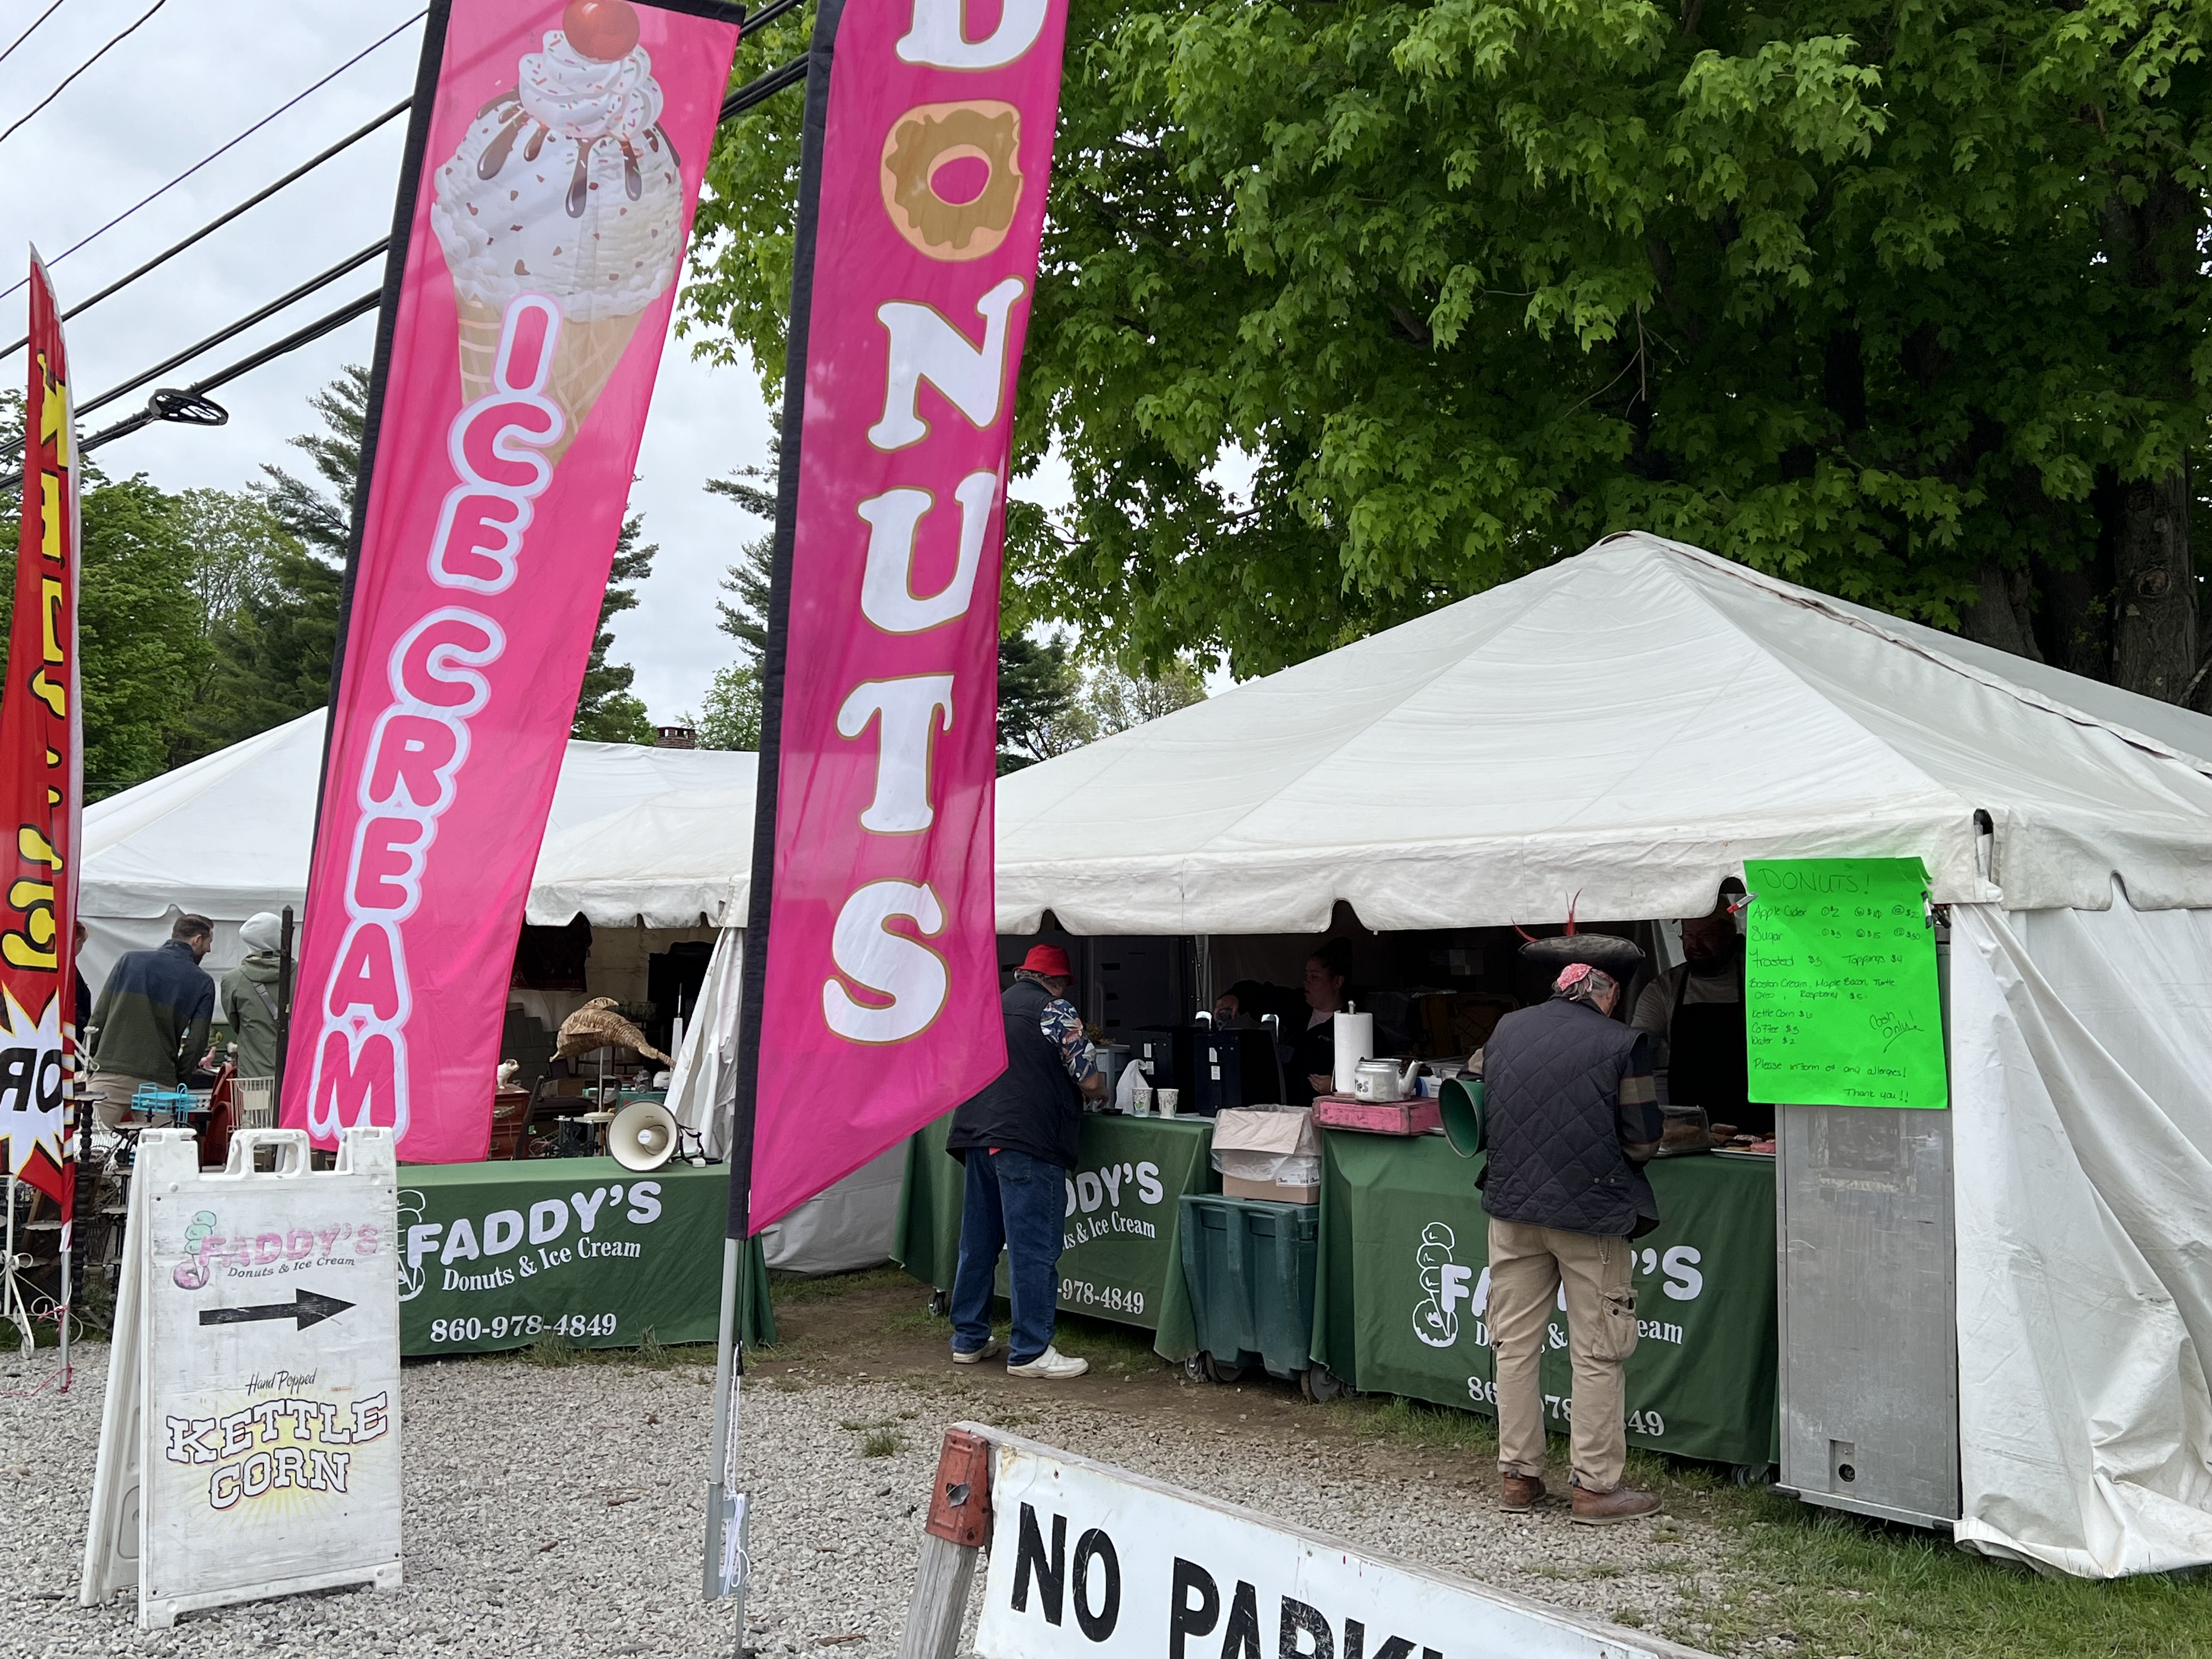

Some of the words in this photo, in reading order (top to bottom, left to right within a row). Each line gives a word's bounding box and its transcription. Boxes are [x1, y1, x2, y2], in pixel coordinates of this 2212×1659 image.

[427, 292, 566, 596] ICE
[308, 605, 507, 1143] CREAM
[1752, 904, 1780, 921] Apple
[1784, 905, 1807, 917] Cider
[1752, 926, 1782, 945] Sugar
[1748, 949, 1793, 968] Frosted
[1841, 954, 1885, 966] Toppings
[1749, 978, 1778, 988] Boston
[1776, 1009, 1795, 1018] Corn
[1753, 1058, 1782, 1070] Please
[1843, 1066, 1860, 1075] any
[1843, 1088, 1876, 1098] Thank
[407, 1181, 662, 1268] FADDY'S
[1076, 1222, 1089, 1244] &
[1087, 1217, 1109, 1238] Ice
[1111, 1211, 1155, 1239] Cream
[199, 1222, 378, 1268] FADDY'S
[227, 1266, 274, 1278] Donuts
[278, 1263, 290, 1273] &
[293, 1260, 312, 1271] Ice
[317, 1257, 355, 1267] Cream
[442, 1268, 515, 1292] Donuts
[518, 1256, 538, 1278] &
[537, 1248, 572, 1271] Ice
[577, 1237, 642, 1259] Cream
[1057, 1278, 1144, 1314] -978-4849
[430, 1312, 617, 1342] 860-978-4849
[1637, 1318, 1683, 1345] eam
[245, 1371, 276, 1396] Hand
[277, 1367, 317, 1395] Popped
[166, 1391, 388, 1465] KETTLE
[209, 1447, 350, 1510] CORN
[1011, 1500, 1120, 1643] NO
